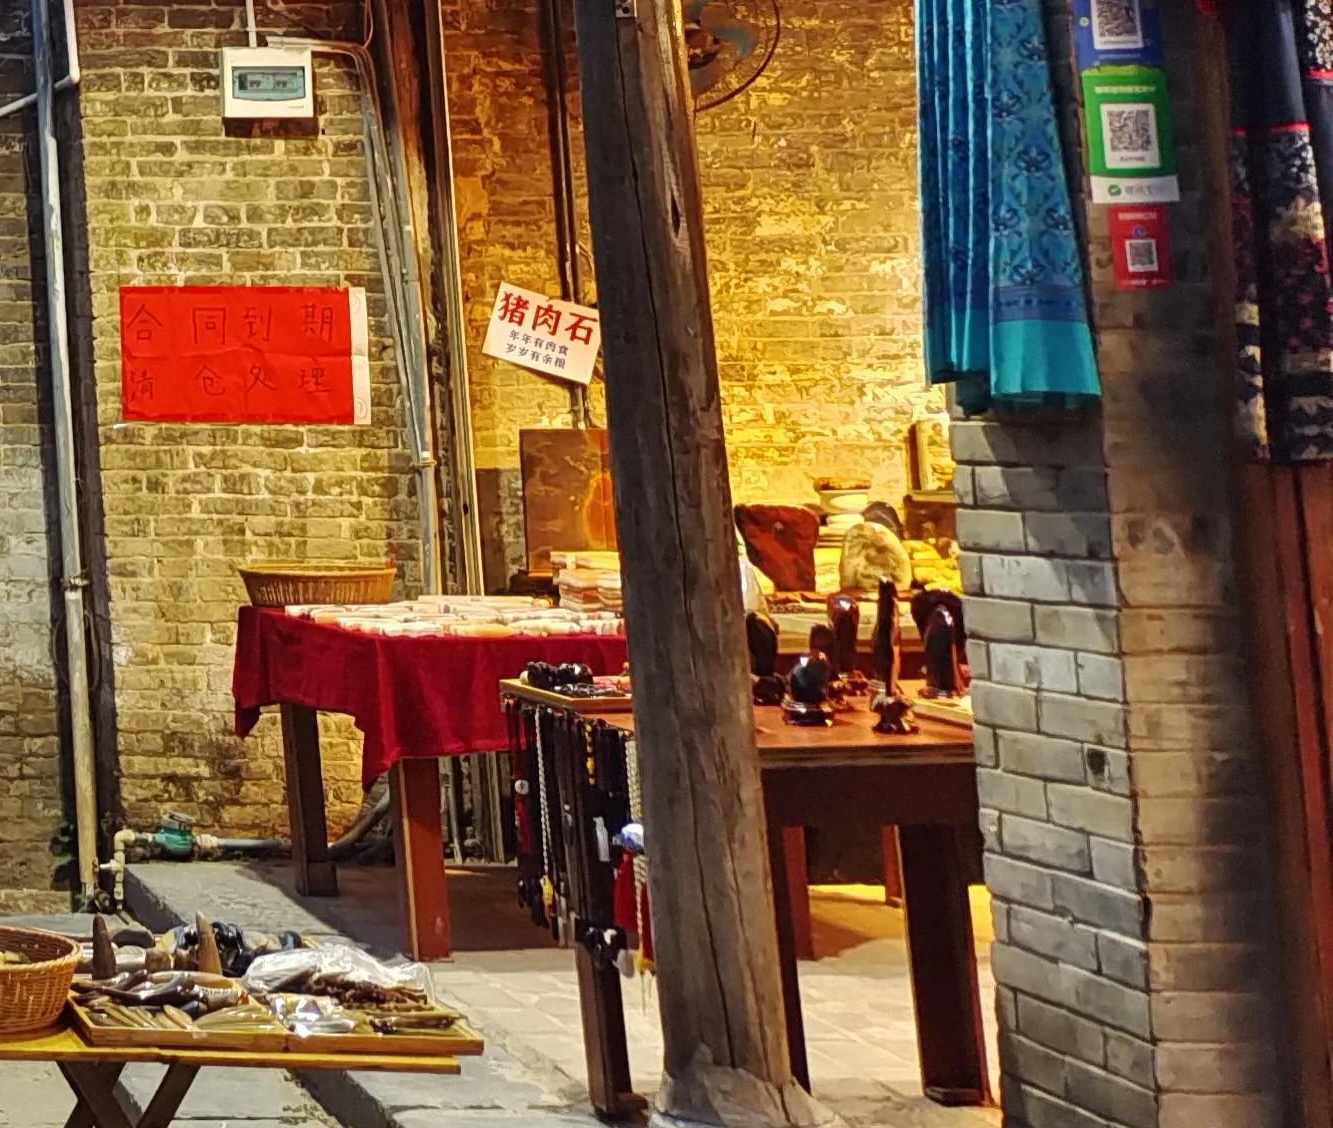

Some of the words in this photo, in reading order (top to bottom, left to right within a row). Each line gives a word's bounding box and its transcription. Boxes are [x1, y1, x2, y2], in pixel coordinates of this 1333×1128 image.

[127, 303, 333, 345] 合同到期
[498, 291, 599, 346] 猪肉石
[504, 343, 567, 370] 岁岁有余粮
[509, 329, 569, 357] 年年有肉食
